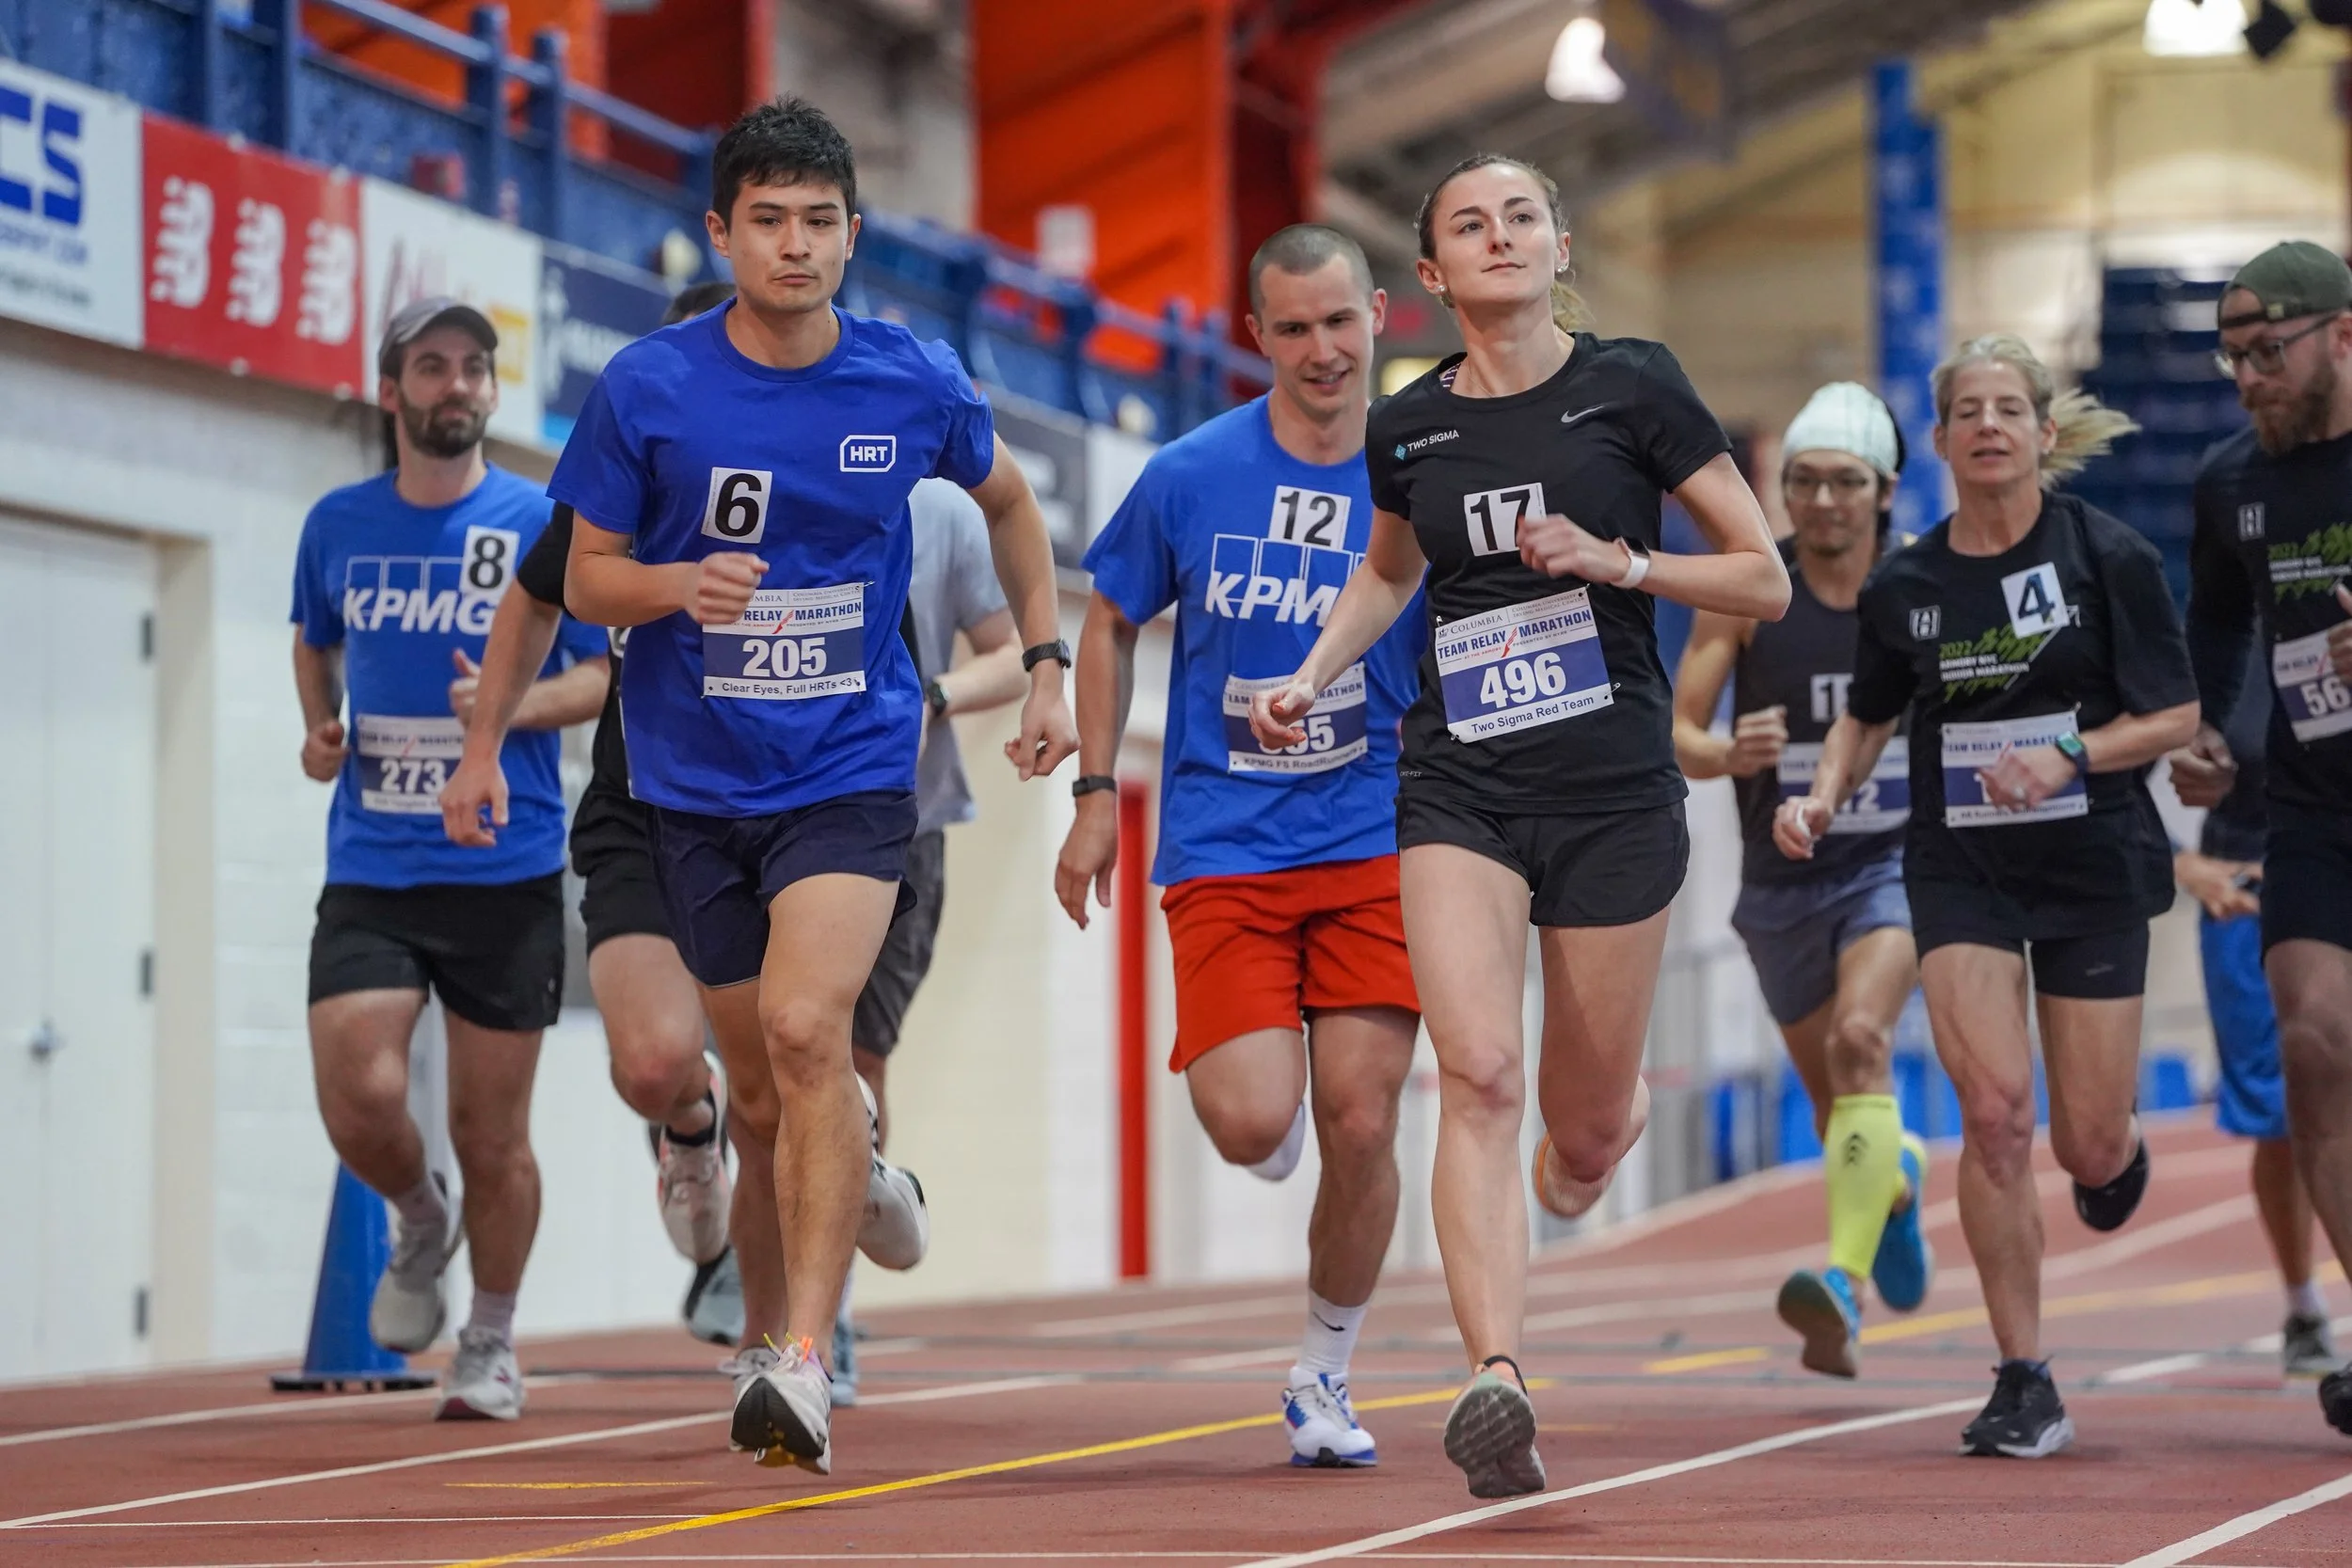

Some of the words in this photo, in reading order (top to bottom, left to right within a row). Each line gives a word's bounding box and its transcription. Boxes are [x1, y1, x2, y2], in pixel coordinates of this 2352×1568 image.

[850, 445, 888, 462] HRT
[1406, 437, 1428, 452] TWO
[1428, 429, 1459, 446] SIGMA
[715, 473, 762, 537] 6
[1280, 490, 1338, 547] 12
[1470, 488, 1531, 551] 17
[468, 536, 506, 589] 8
[342, 588, 499, 635] KPMG
[744, 610, 783, 621] RELAY
[795, 601, 862, 621] MARATHON
[1204, 571, 1341, 628] KPM
[2017, 572, 2056, 624] 4
[1438, 641, 1469, 659] TEAM
[1470, 630, 1506, 650] RELAY
[1518, 610, 1592, 638] MARATHON
[1451, 614, 1503, 634] COLUMBIA
[742, 637, 827, 678] 205
[722, 682, 751, 692] Clear
[754, 684, 783, 694] Eyes,
[786, 684, 806, 693] Full
[809, 680, 837, 692] HRTs
[1315, 681, 1363, 700] RATHON
[1479, 652, 1566, 709] 496
[1471, 721, 1495, 734] Two
[1497, 712, 1534, 727] Sigma
[1536, 705, 1559, 718] Red
[1562, 695, 1595, 711] Team
[380, 758, 446, 795] 273
[1244, 756, 1274, 768] KPMG
[1276, 758, 1290, 768] FS
